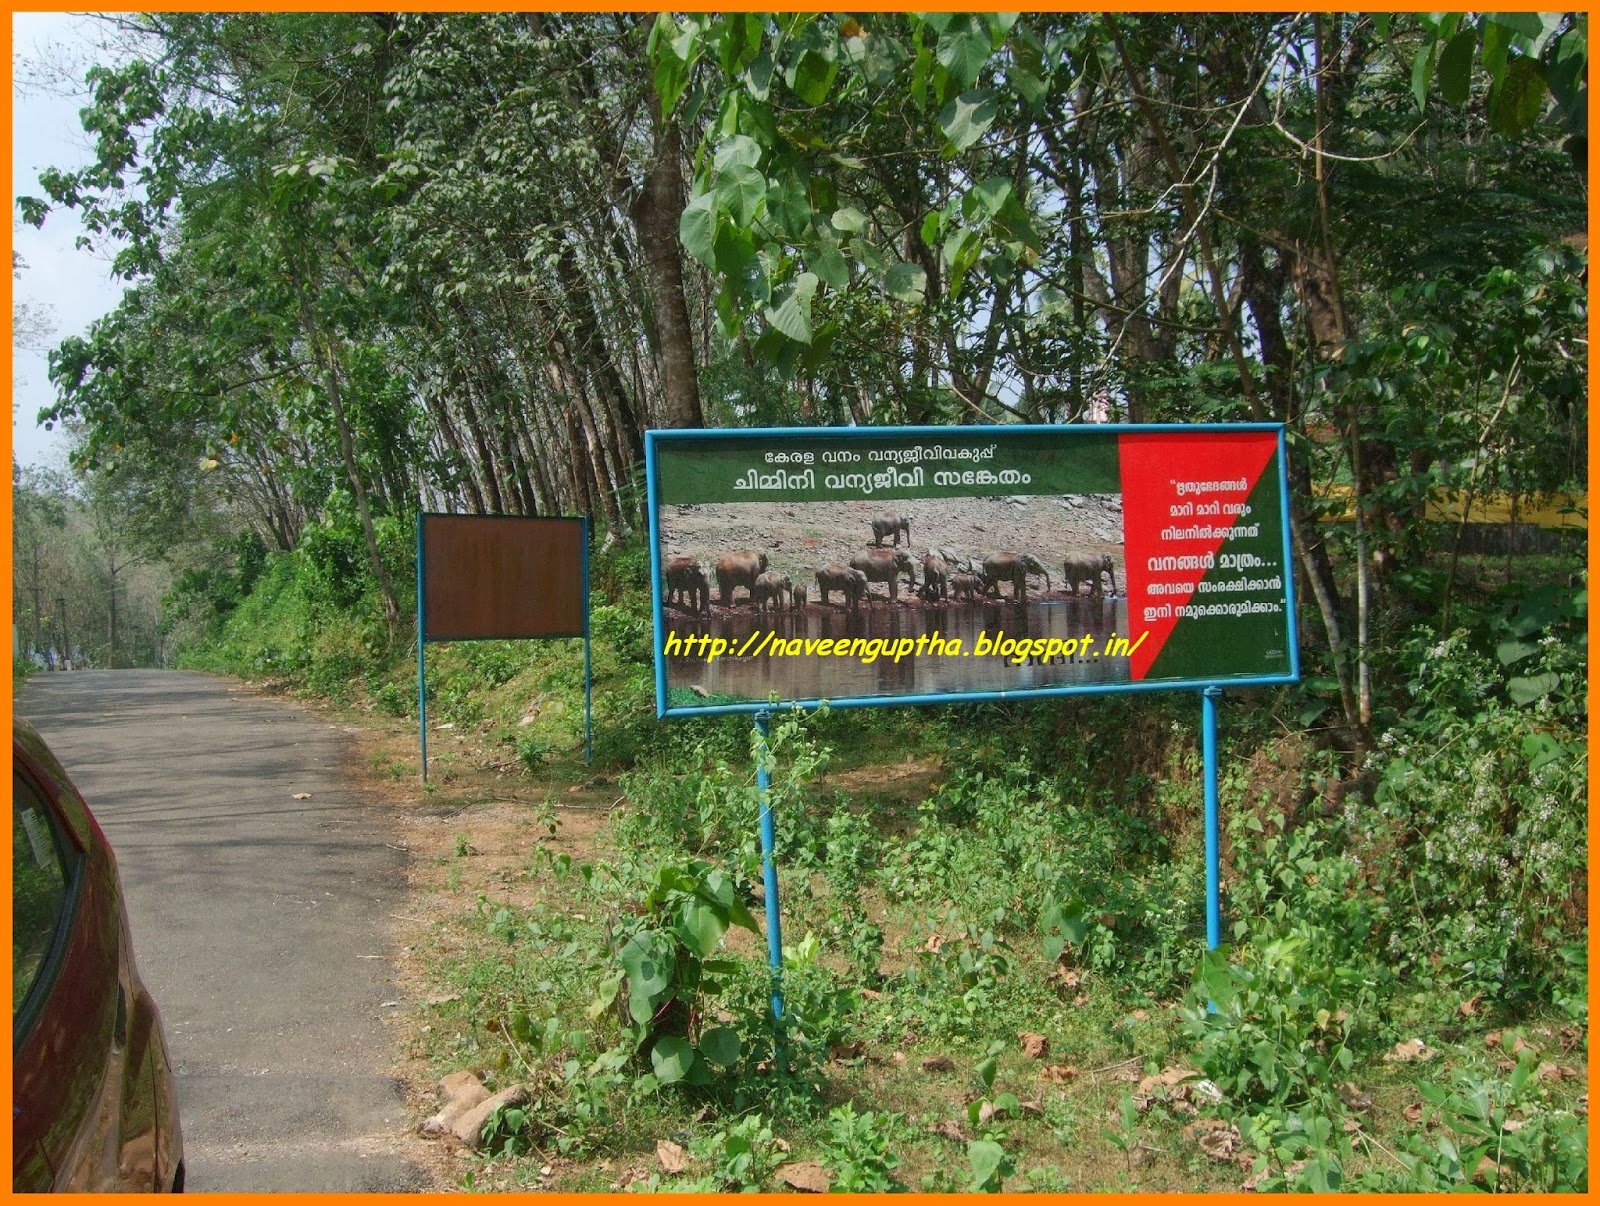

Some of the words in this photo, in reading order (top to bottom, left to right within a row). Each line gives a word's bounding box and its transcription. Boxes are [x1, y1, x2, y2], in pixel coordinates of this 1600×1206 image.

[765, 450, 815, 466] കേരള
[822, 449, 861, 462] വനം
[868, 444, 997, 466] വന്യജീവിവകുപ്പ്
[733, 467, 815, 490] ചിമ്മിനി
[825, 466, 924, 494] വന്യജീവി
[934, 467, 1032, 486] സങ്കേതം
[1170, 501, 1193, 517] മാറി
[1196, 500, 1219, 516] മാറി
[1223, 502, 1252, 517] വരും
[1161, 522, 1260, 541] നിലനിൽക്കുന്നത്
[1147, 551, 1215, 571] വനങ്ങൾ
[1147, 582, 1195, 595] അവയെ
[1198, 575, 1282, 594] സംരക്ഷിക്കാൻ
[1143, 603, 1172, 622] ഇനി
